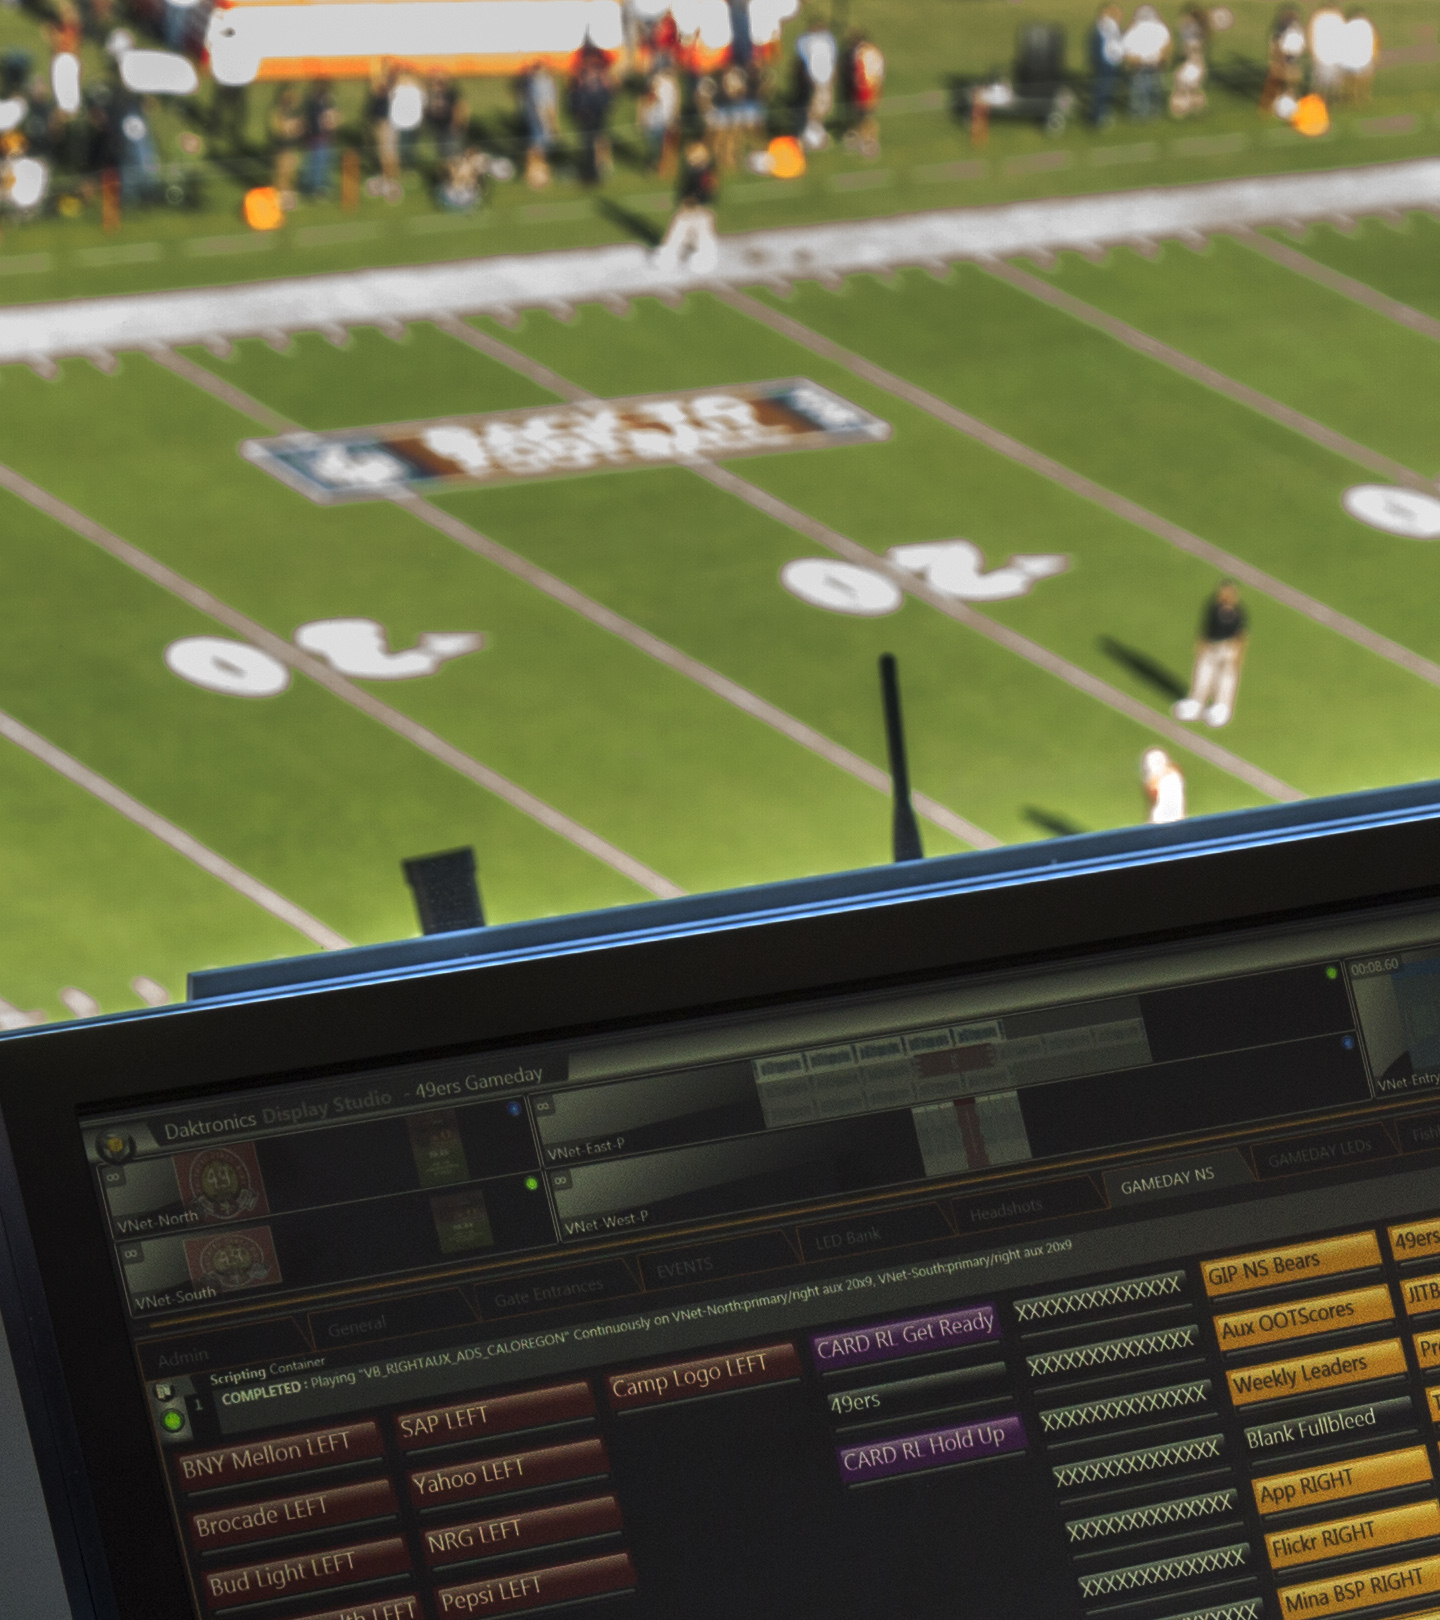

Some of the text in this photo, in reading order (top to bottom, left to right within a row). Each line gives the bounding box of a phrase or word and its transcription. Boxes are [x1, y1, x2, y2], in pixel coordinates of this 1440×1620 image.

[1349, 956, 1400, 977] 00:08.60
[162, 1064, 545, 1141] Daktronics Display Studio 49ers Gameday
[546, 1136, 627, 1163] VNet-East-P
[1119, 1165, 1216, 1196] GAMEDAY NS
[116, 1207, 200, 1235] VNet-North
[563, 1208, 650, 1237] VNet-West-P
[1206, 1248, 1321, 1286] GIP NS Bears
[134, 1283, 218, 1311] VNet-South
[815, 1307, 998, 1361] CARD RL Get Ready
[1219, 1297, 1356, 1339] Aux OOTScores
[208, 1354, 326, 1389] Scripting Container
[610, 1351, 770, 1403] Camp Logo LEFT
[1231, 1350, 1369, 1398] Weekly Leaders
[399, 1403, 491, 1440] SAP LEFT
[828, 1389, 882, 1416] 49ers
[841, 1422, 1008, 1473] CARD RL Hold Up
[1245, 1406, 1377, 1450] Blank Fullbleed
[181, 1429, 353, 1481] BNY Mellon LEFT
[412, 1457, 528, 1497] Yahoo LEFT
[1258, 1466, 1355, 1507] App RIGHT
[195, 1494, 331, 1539] Brocade LEFT
[426, 1517, 525, 1554] NRG LEFT
[1270, 1518, 1377, 1559] Flickr RIGHT
[208, 1550, 358, 1598] Bud Light LEFT
[440, 1575, 543, 1617] Pepsi LEFT
